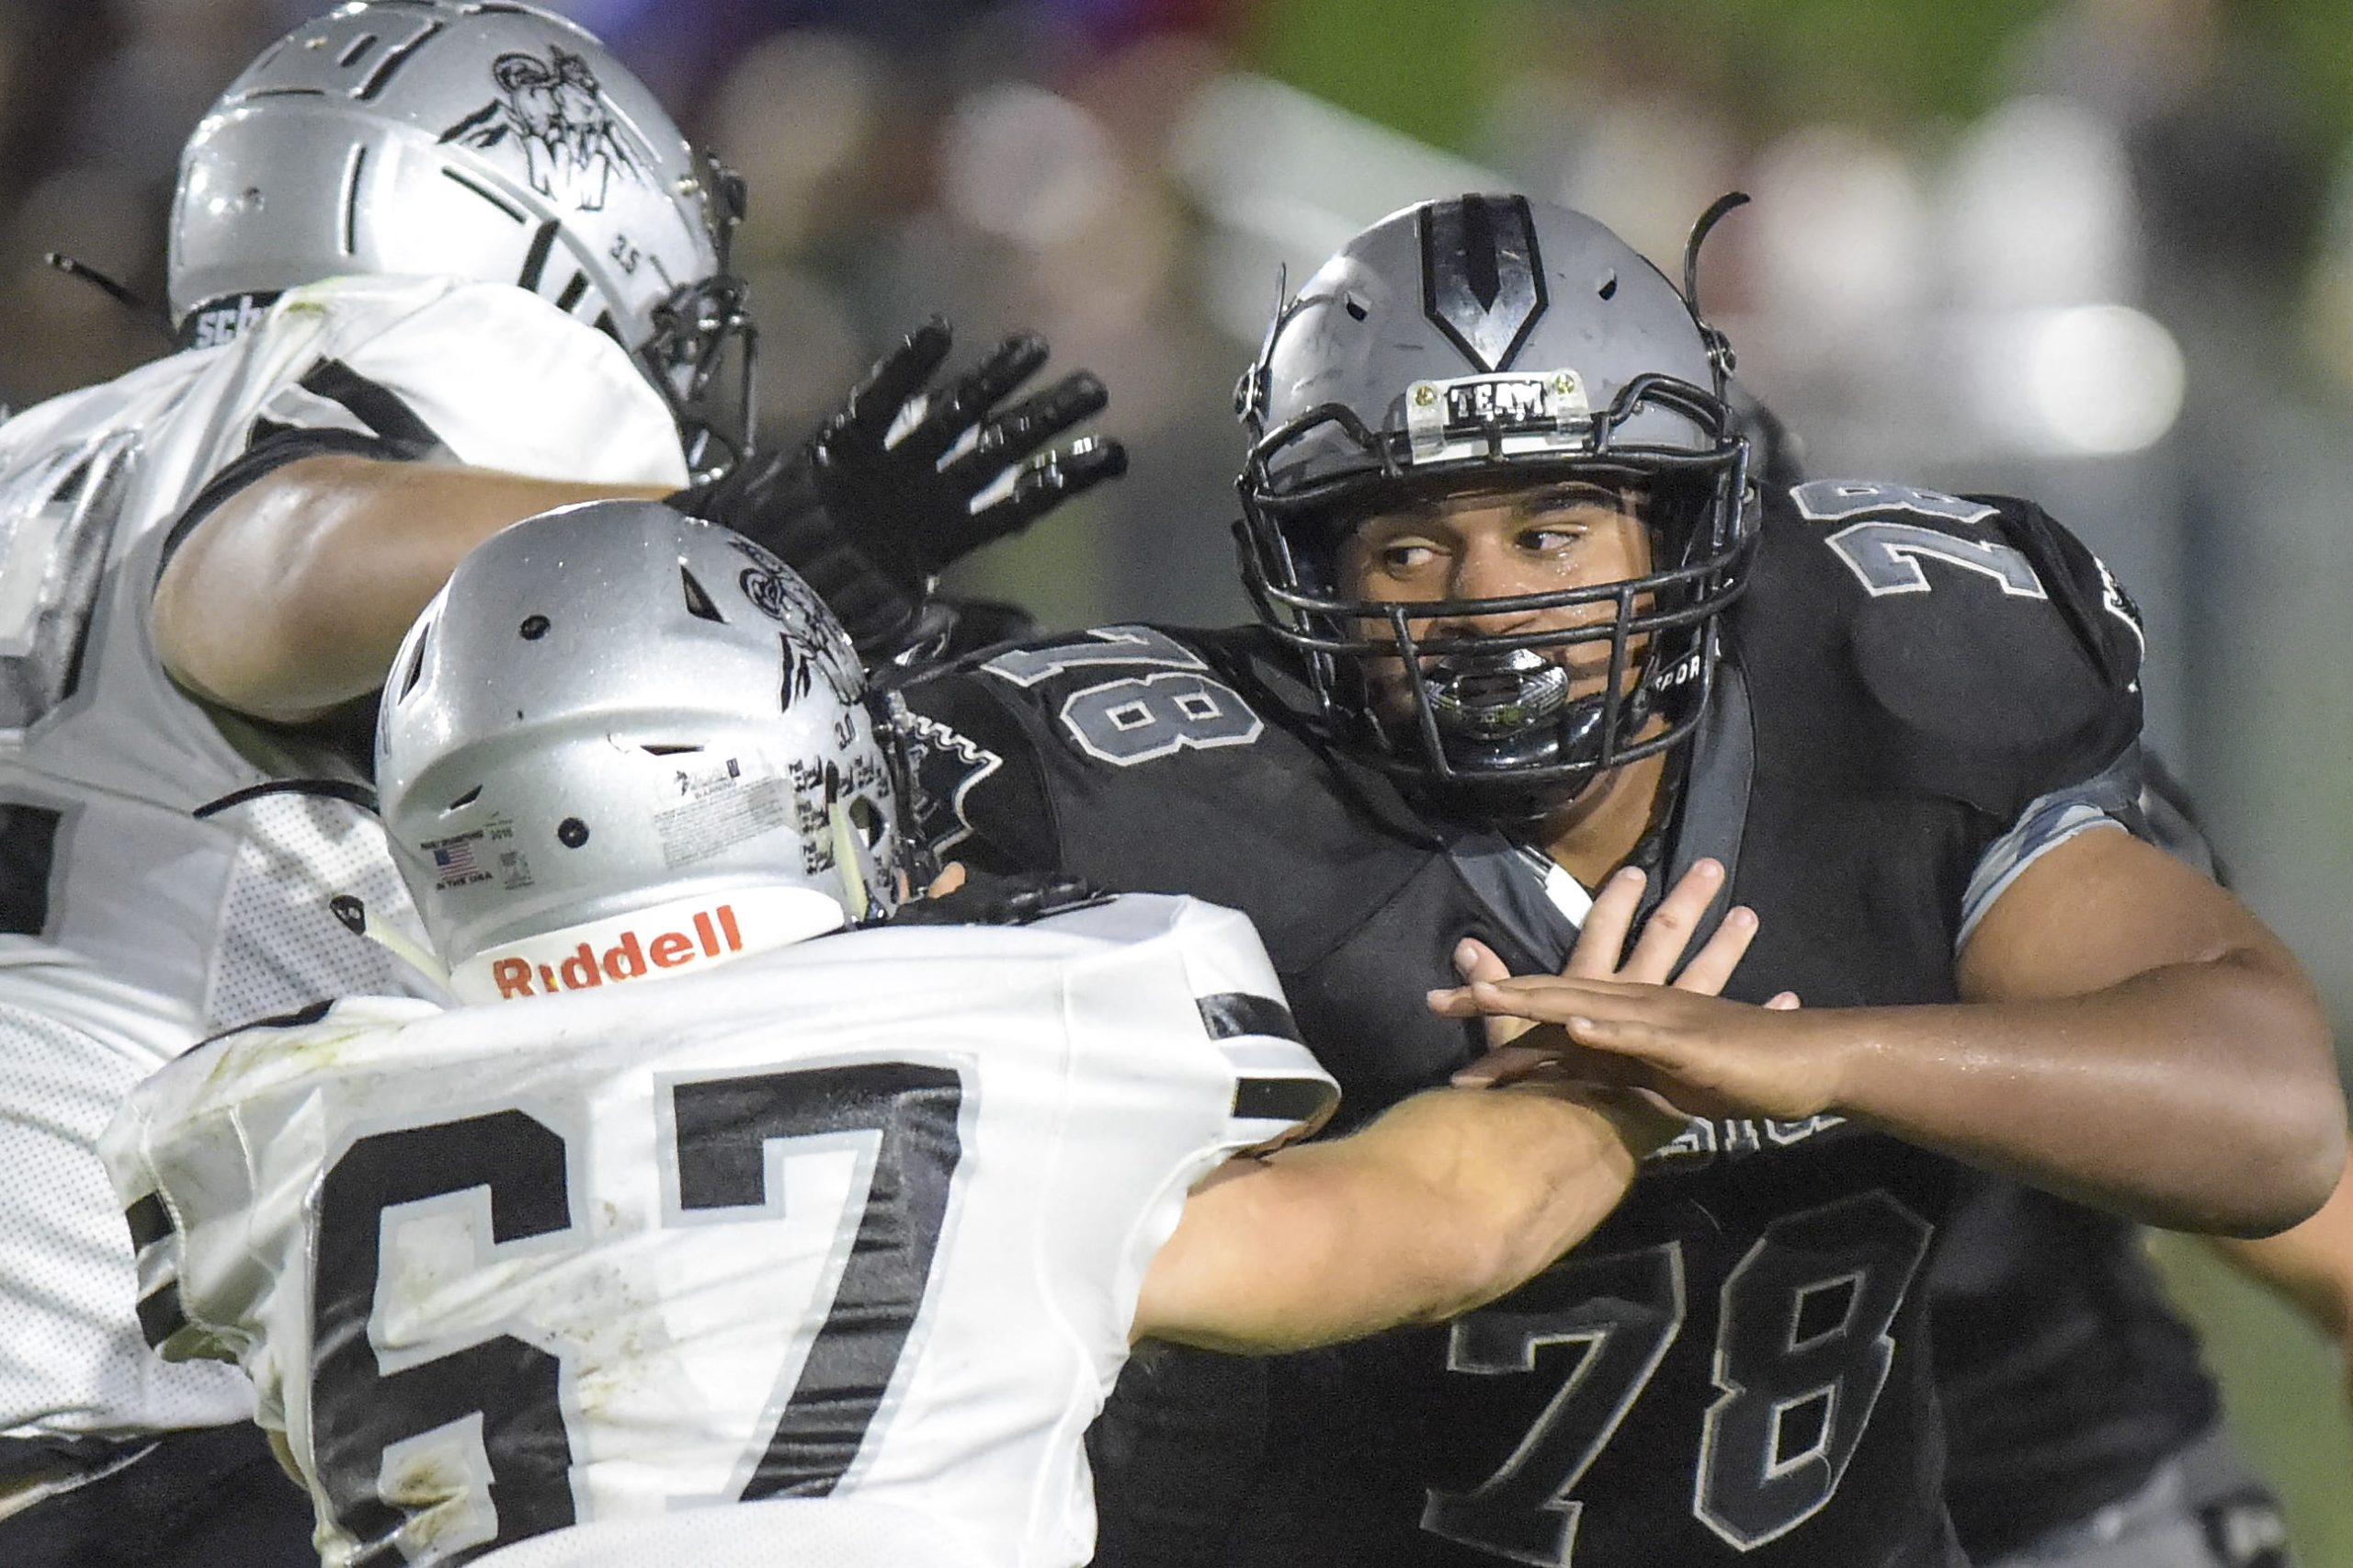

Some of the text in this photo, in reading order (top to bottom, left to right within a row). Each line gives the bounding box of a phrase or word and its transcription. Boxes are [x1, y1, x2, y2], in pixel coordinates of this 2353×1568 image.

[1449, 379, 1546, 417] TEAM
[493, 904, 744, 1000] Riddell
[308, 1055, 976, 1566] 67
[1420, 1190, 1934, 1568] 78
